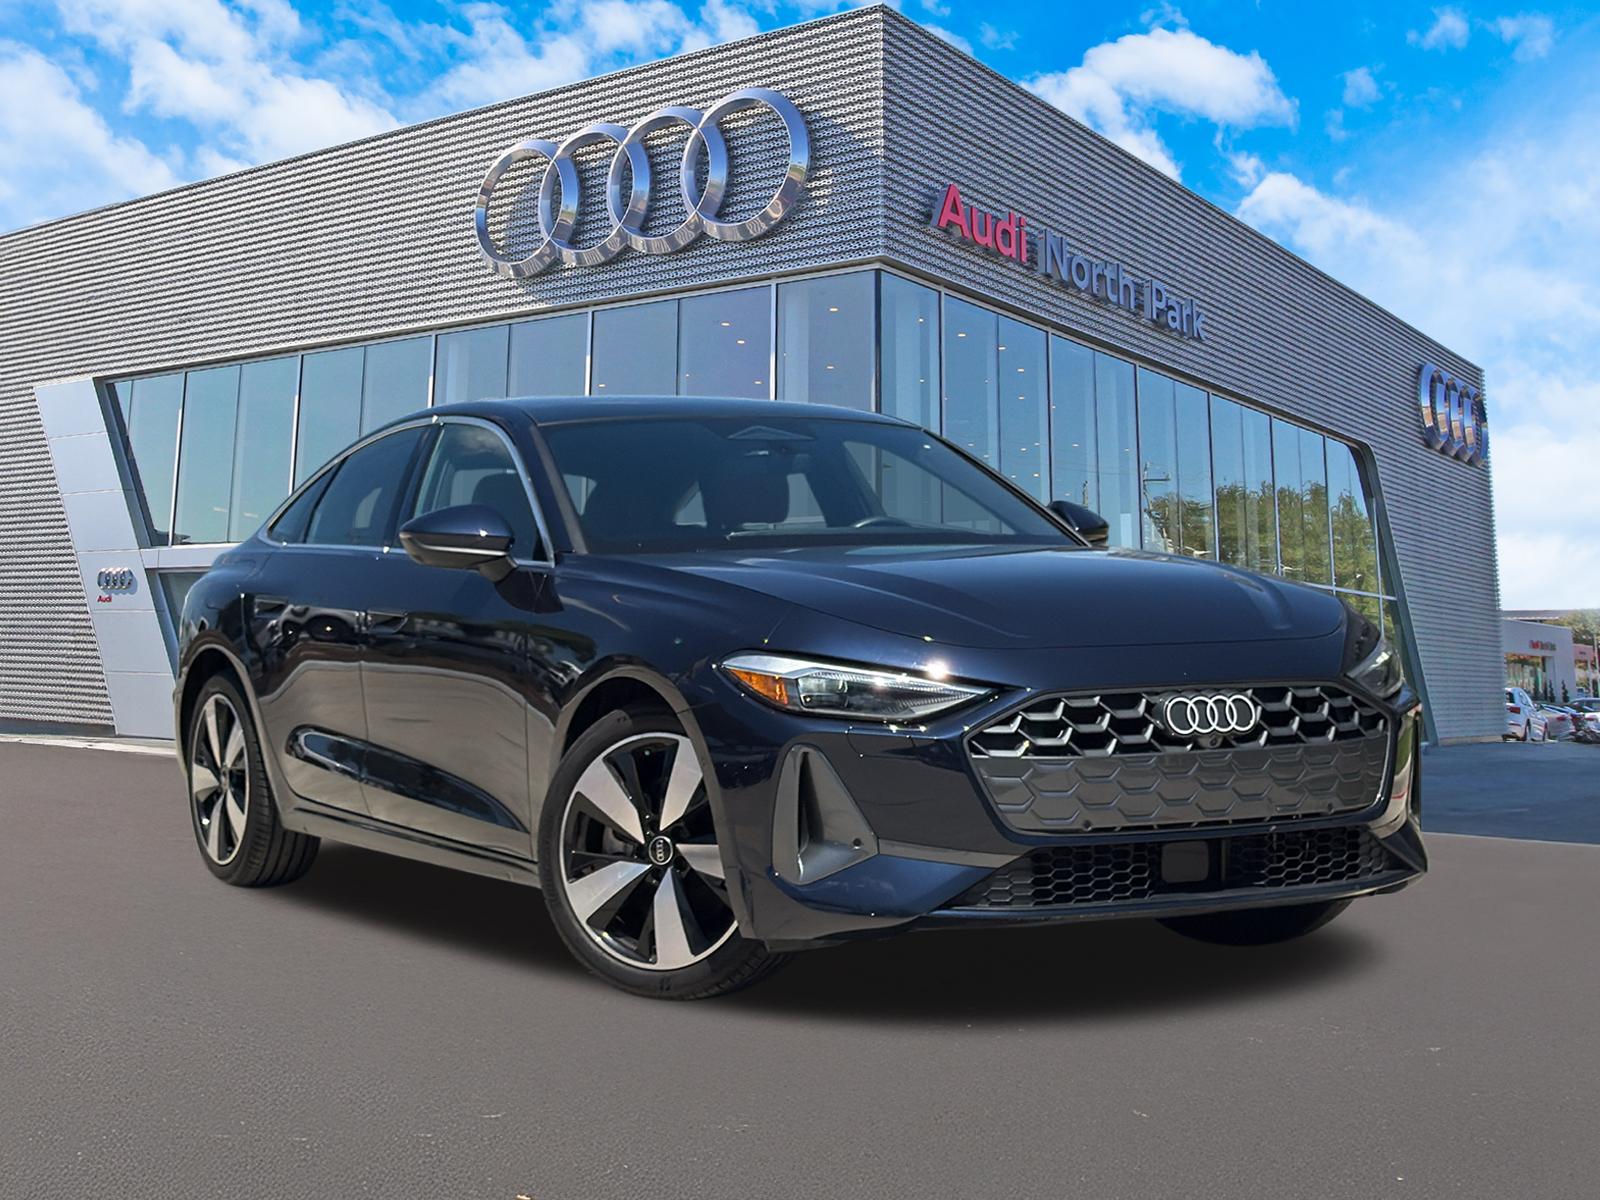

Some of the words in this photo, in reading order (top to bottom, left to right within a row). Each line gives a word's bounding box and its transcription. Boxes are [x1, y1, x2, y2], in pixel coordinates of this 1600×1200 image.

[934, 183, 1028, 263] Audi
[1042, 231, 1136, 312] North
[1147, 278, 1206, 340] Park
